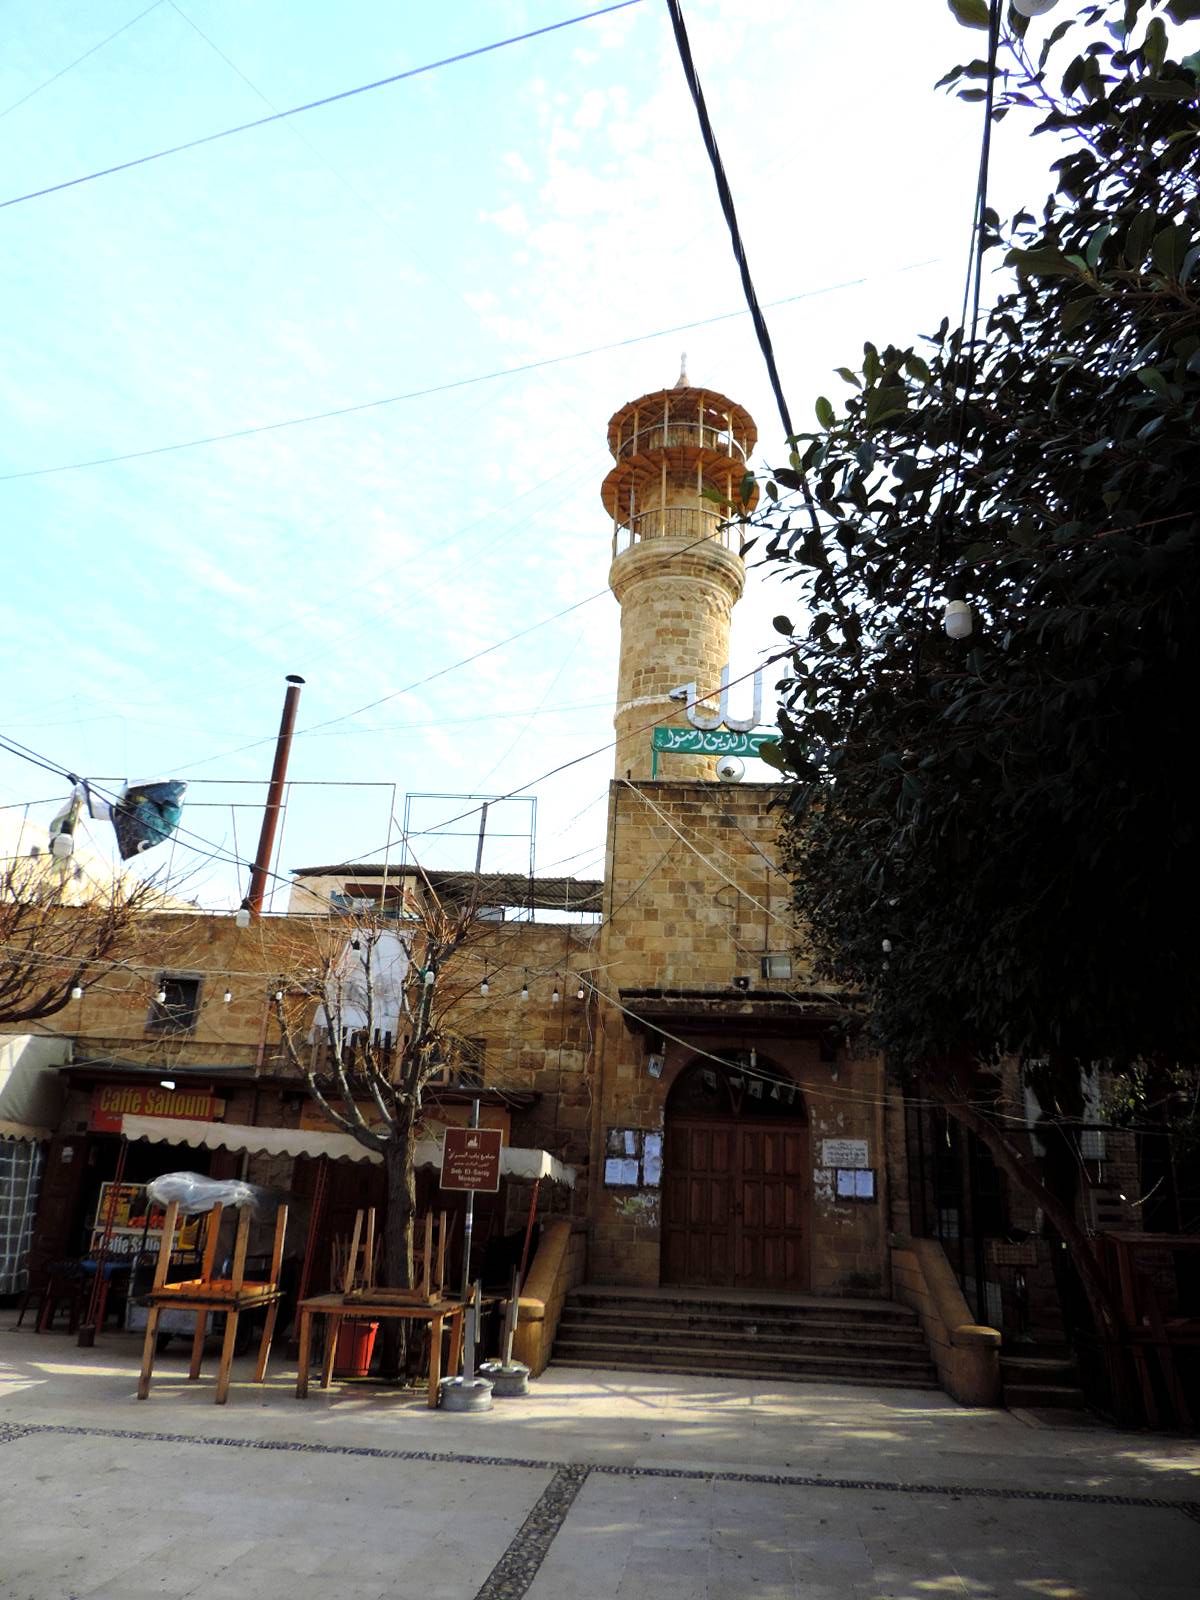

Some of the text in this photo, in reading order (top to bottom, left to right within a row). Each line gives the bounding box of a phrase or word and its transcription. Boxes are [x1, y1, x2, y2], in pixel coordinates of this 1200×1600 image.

[703, 732, 747, 752] الذين
[100, 1087, 211, 1116] Caffe Salloum
